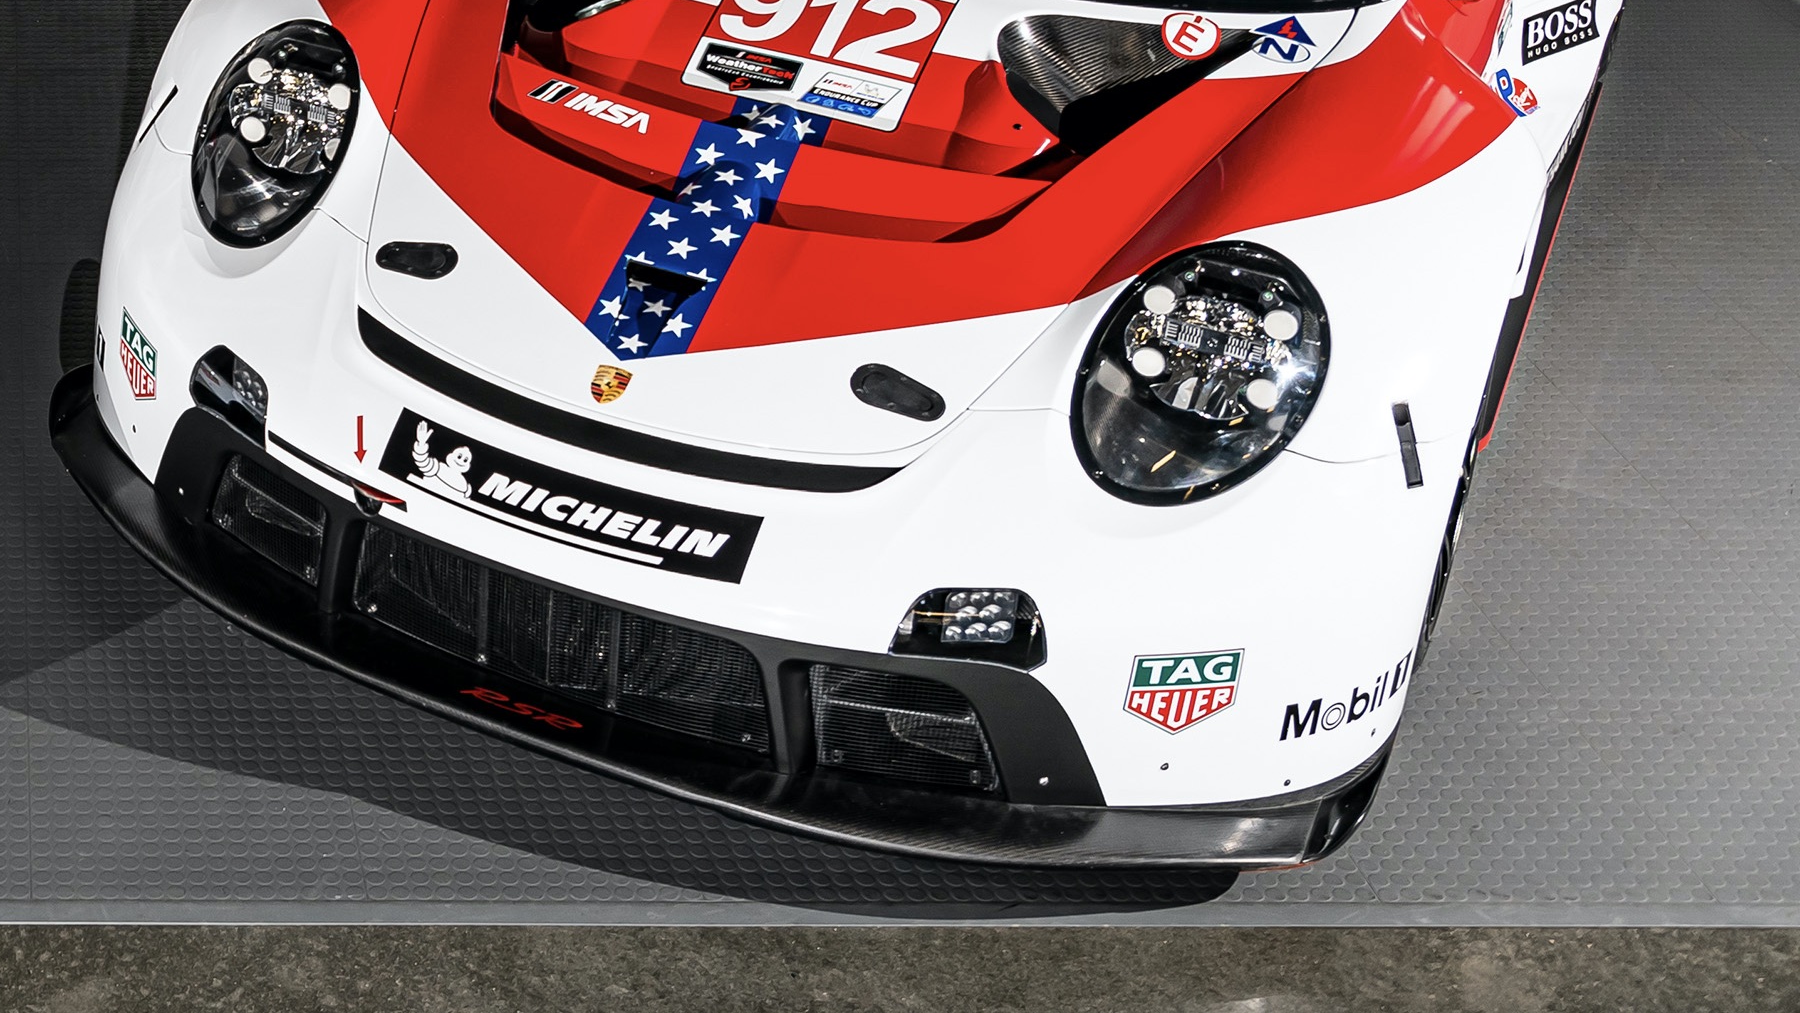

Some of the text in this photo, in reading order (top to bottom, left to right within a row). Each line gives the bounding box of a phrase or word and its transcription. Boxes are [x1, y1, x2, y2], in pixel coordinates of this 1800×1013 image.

[1526, 0, 1592, 48] BOSS
[1527, 28, 1593, 58] HUGO BOSS
[706, 54, 794, 80] WeatherTech
[563, 92, 650, 134] IMSA
[124, 316, 154, 372] TAG
[121, 343, 154, 395] HEUER
[477, 472, 730, 558] MICHELIN
[1142, 655, 1234, 685] TAG
[460, 686, 583, 730] RSR
[1131, 688, 1232, 728] HEUER
[1279, 670, 1389, 741] Mobil
